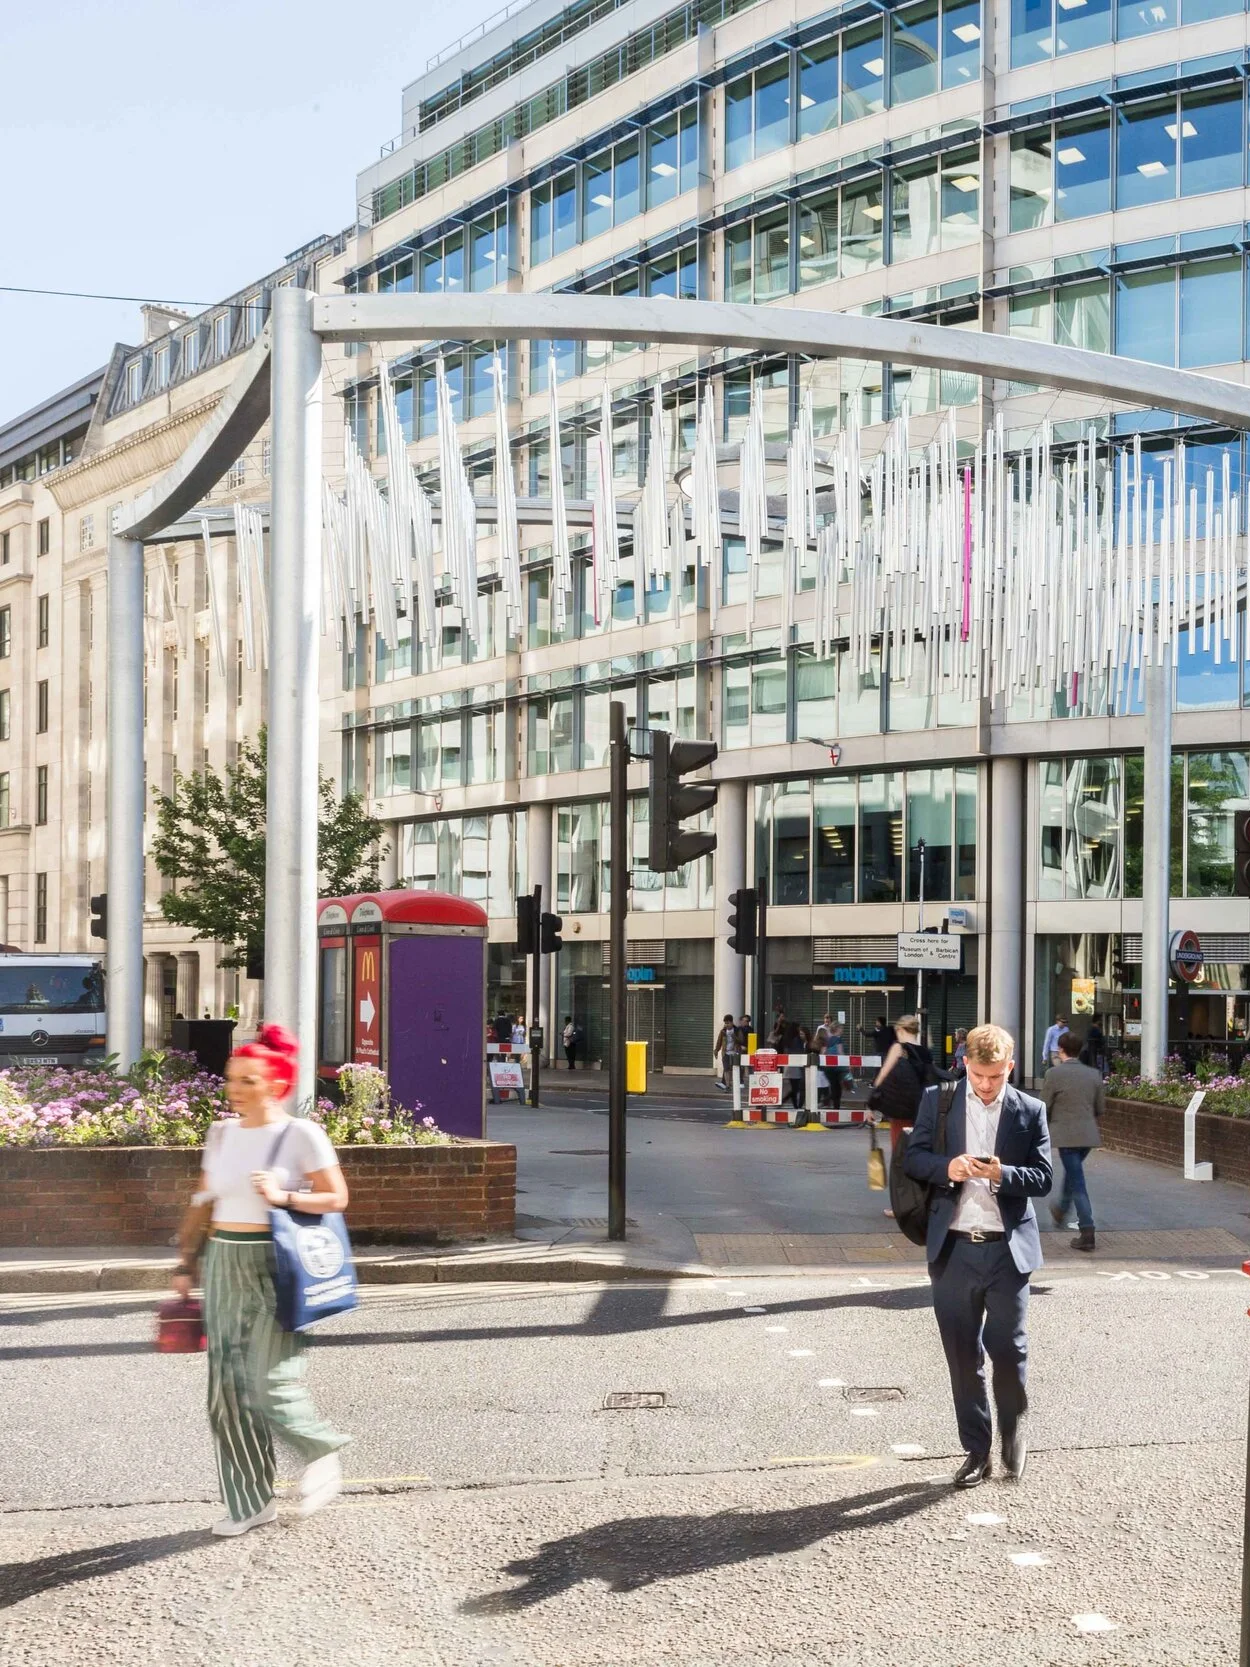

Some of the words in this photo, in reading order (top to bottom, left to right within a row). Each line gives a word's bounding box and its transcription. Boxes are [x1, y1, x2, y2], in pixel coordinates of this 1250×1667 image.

[627, 966, 655, 983] aplin
[834, 964, 887, 985] maplin
[752, 1096, 777, 1104] smoking
